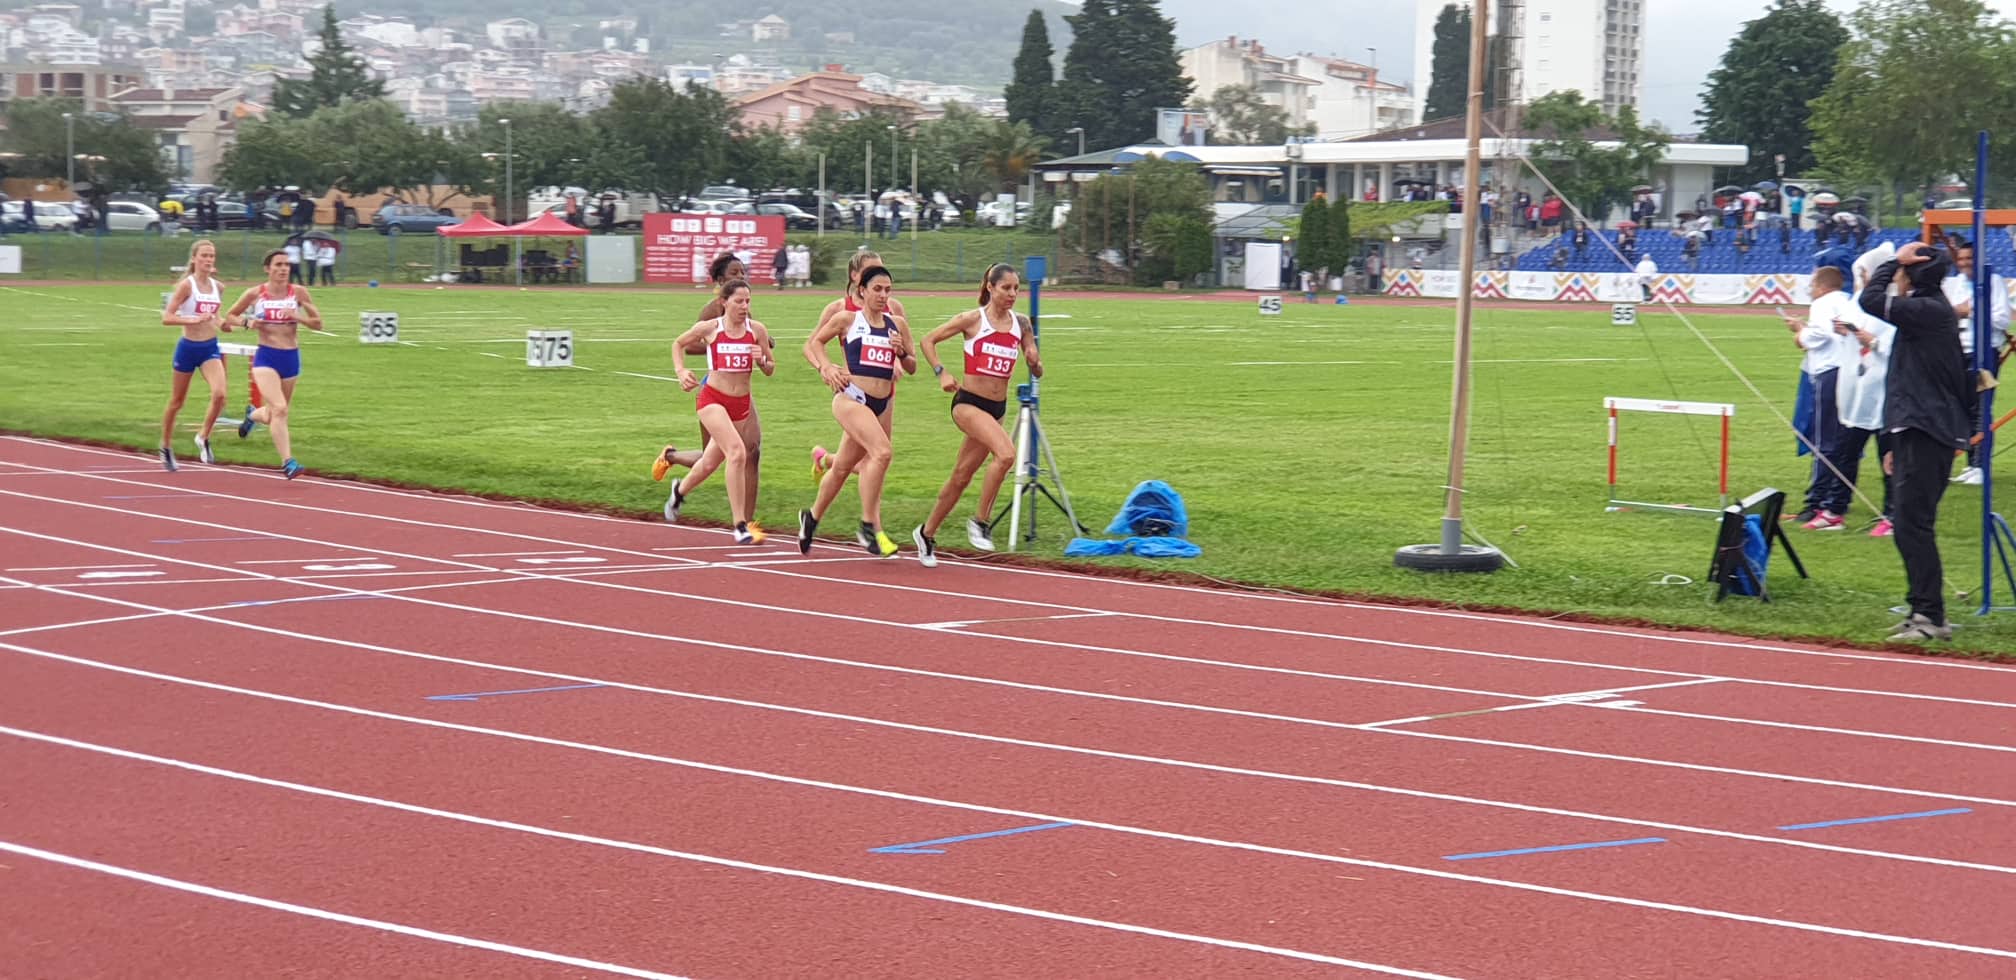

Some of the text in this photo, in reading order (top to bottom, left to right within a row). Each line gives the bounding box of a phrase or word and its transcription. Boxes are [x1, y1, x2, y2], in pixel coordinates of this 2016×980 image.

[656, 234, 692, 245] HOW
[692, 235, 717, 246] BIG
[717, 236, 740, 246] WE
[1259, 298, 1281, 311] 45
[269, 310, 289, 320] 10
[1614, 306, 1634, 321] 55
[370, 317, 397, 337] 65
[545, 336, 571, 360] 75
[867, 348, 892, 363] 068
[725, 355, 748, 368] 135
[987, 356, 1011, 373] 133
